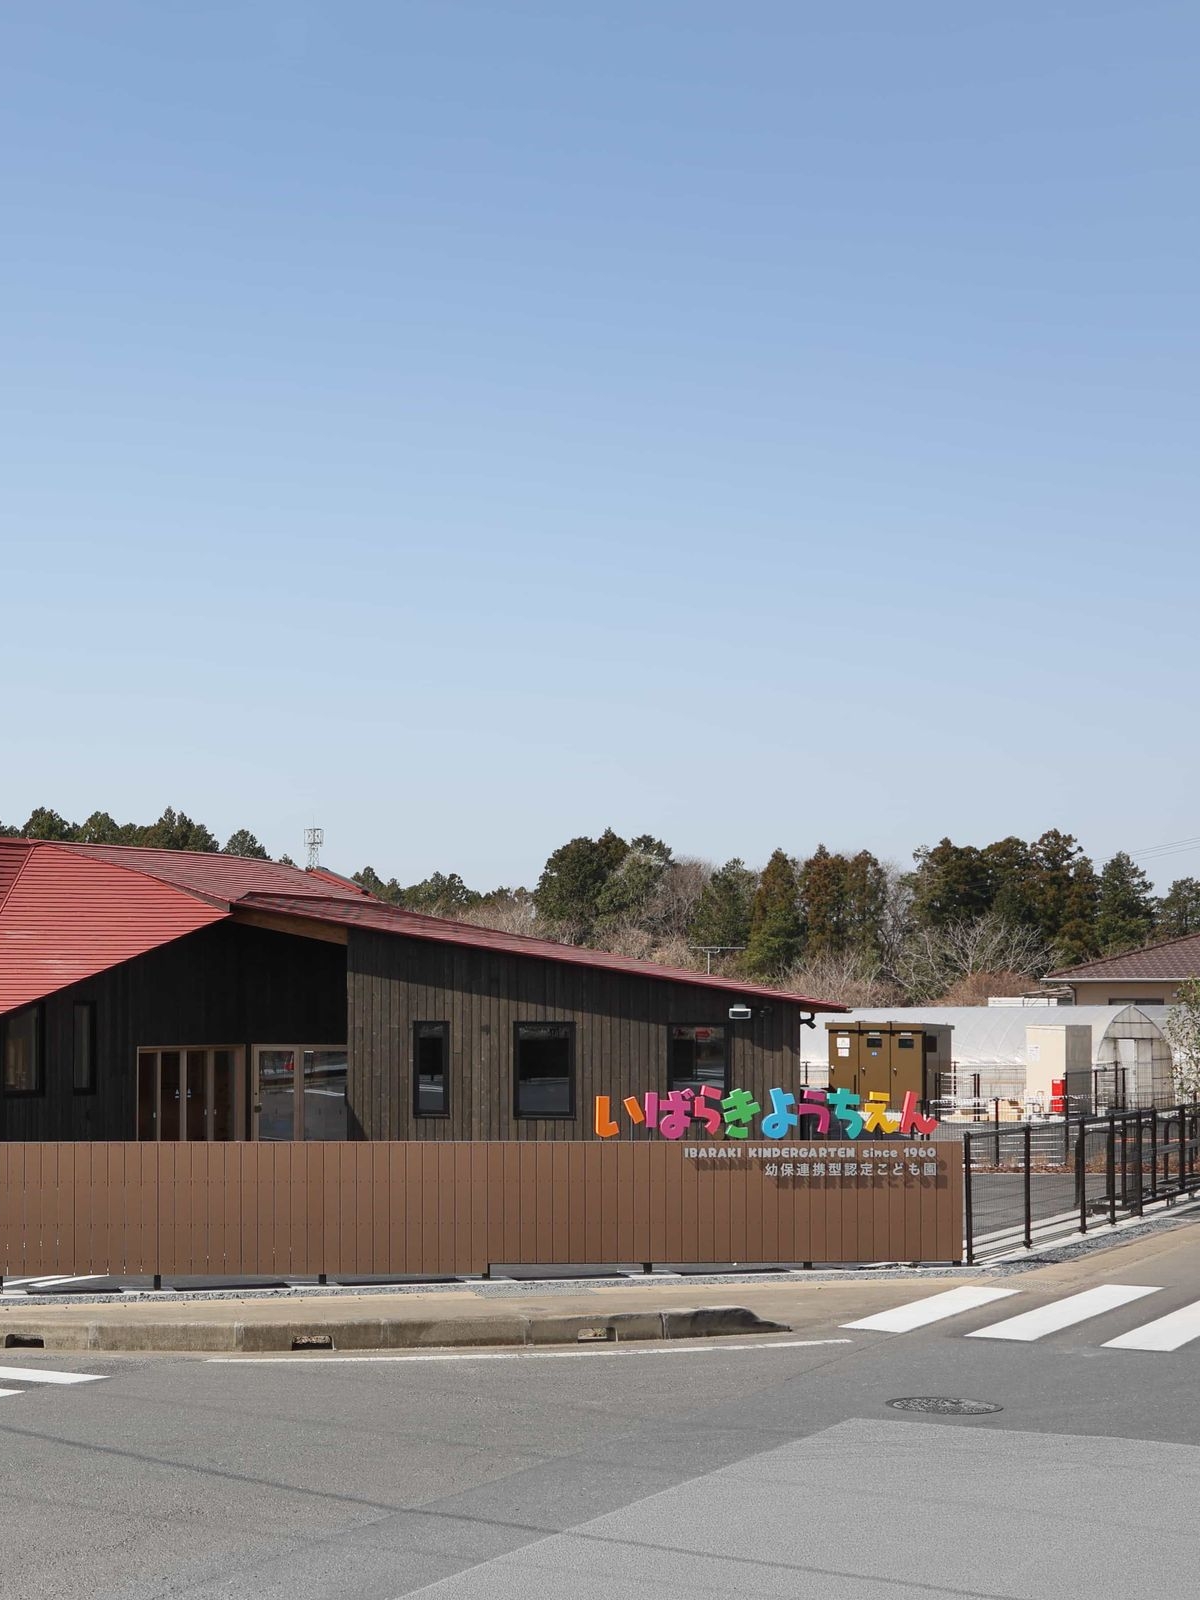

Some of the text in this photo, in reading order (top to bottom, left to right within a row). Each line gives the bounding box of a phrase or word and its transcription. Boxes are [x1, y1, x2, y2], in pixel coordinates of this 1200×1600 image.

[594, 1084, 938, 1140] いばらきようちえん
[684, 1147, 937, 1158] IBARAKI KINDERGARTEN since 1960
[764, 1162, 937, 1177] 幼保連携型認定こども園
